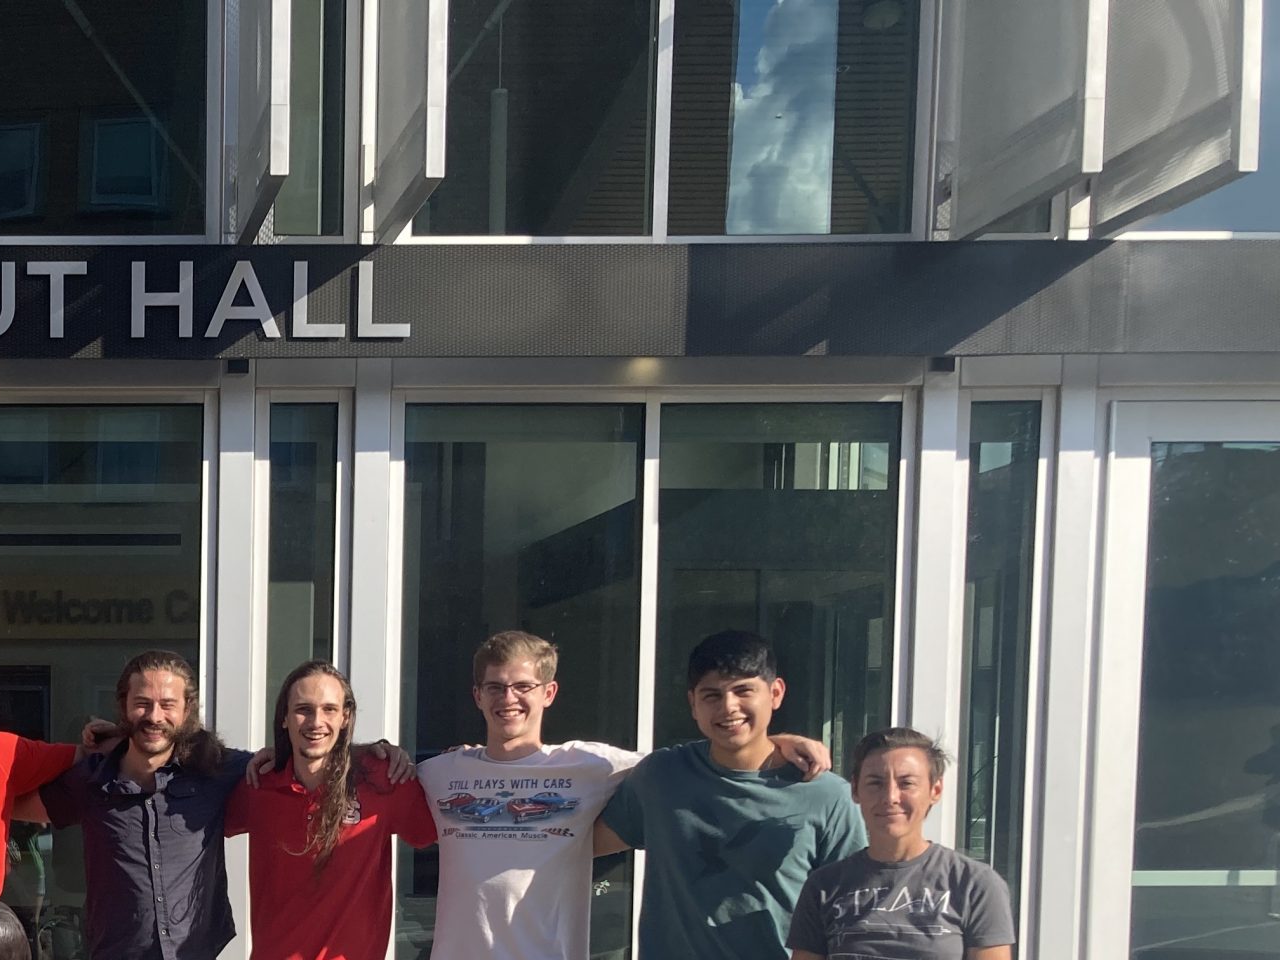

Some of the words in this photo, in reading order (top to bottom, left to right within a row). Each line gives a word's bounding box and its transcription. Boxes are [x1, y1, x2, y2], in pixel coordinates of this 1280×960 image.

[130, 260, 412, 339] HALL
[1, 589, 154, 624] Welcome
[448, 780, 469, 791] STILL
[473, 779, 505, 790] PLAYS
[510, 779, 538, 789] WITH
[543, 778, 572, 789] CARS
